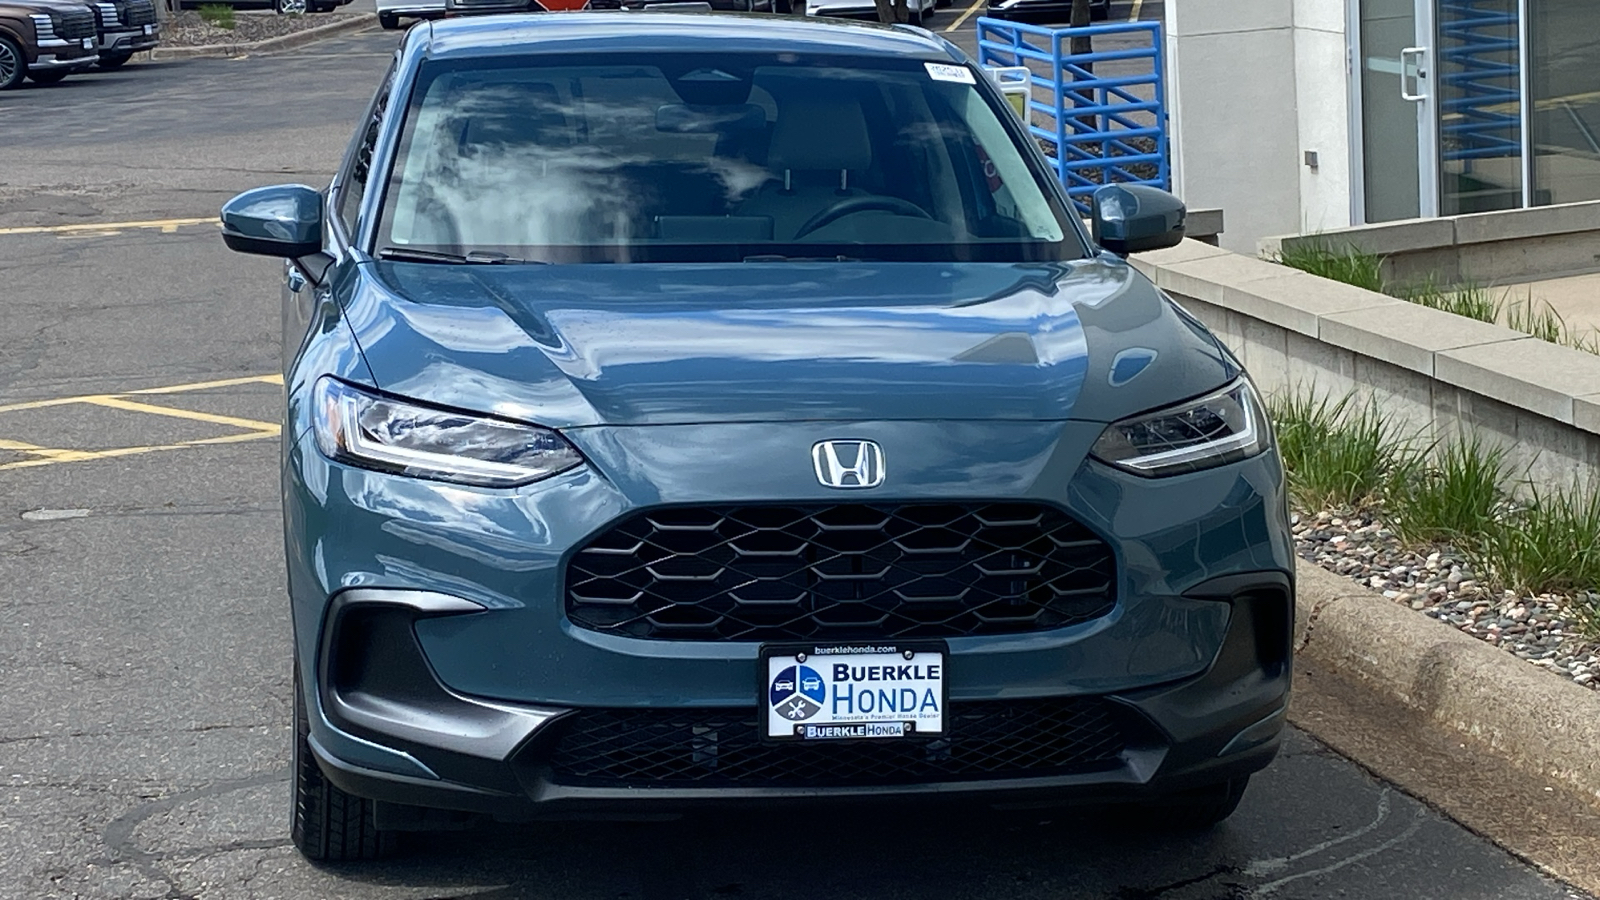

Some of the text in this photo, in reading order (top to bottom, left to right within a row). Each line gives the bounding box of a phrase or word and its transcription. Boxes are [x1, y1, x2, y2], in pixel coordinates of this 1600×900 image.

[814, 645, 897, 655] buerklehonda.com
[832, 663, 941, 682] BUERKLE
[832, 684, 939, 715] HONDA
[807, 723, 902, 738] BUERKLE HONDA
